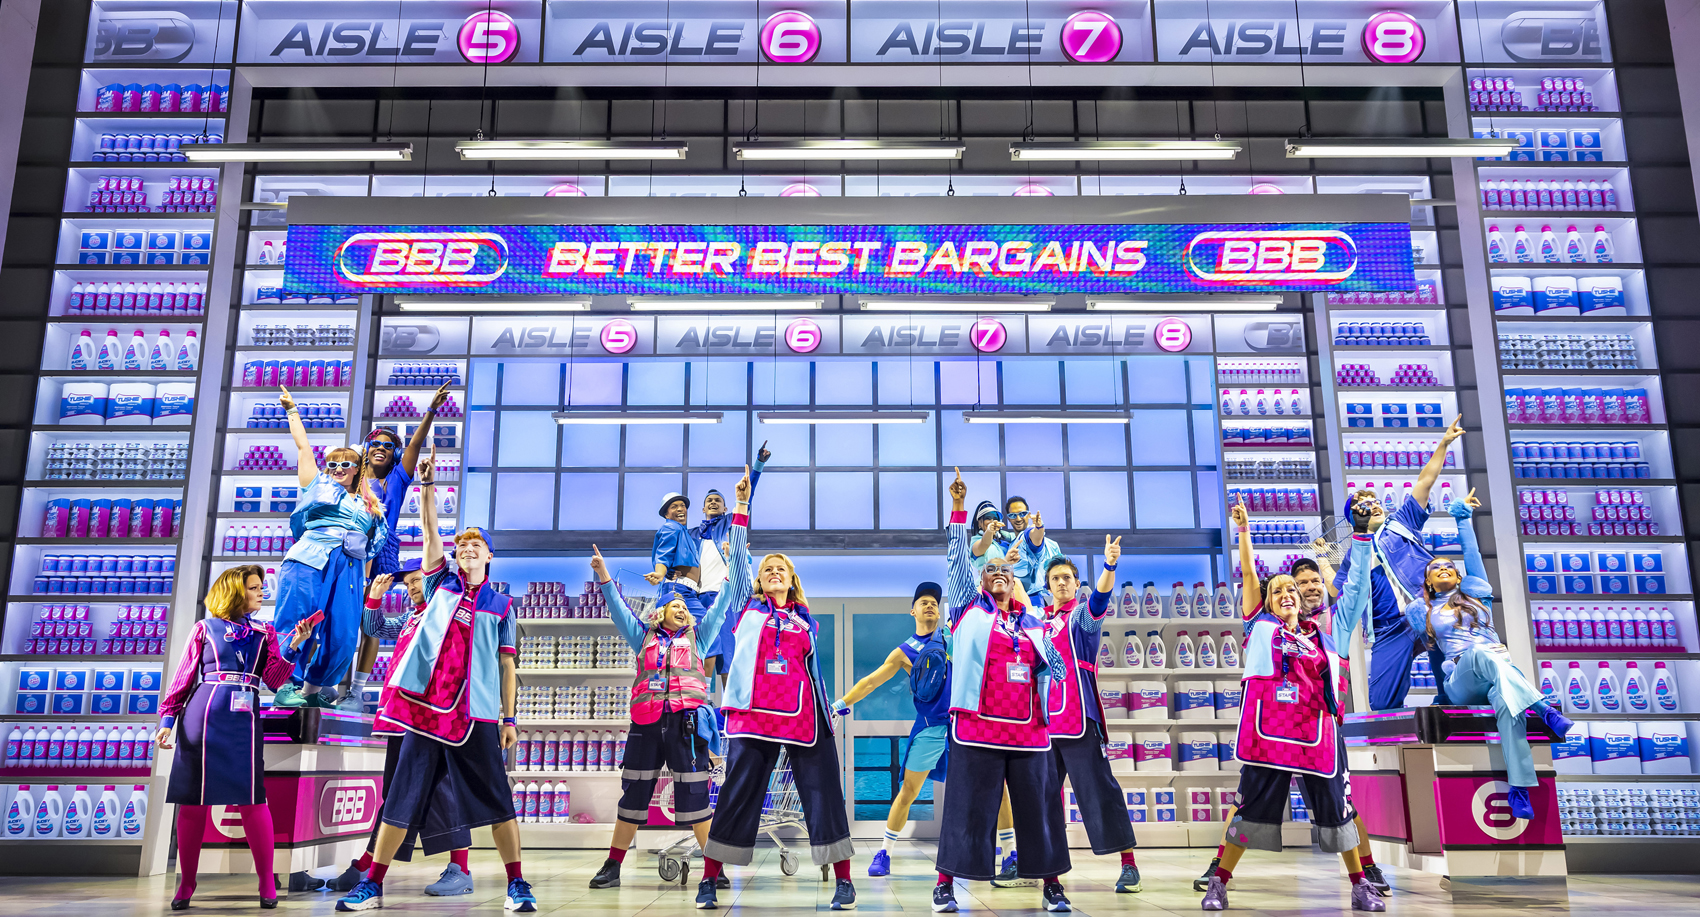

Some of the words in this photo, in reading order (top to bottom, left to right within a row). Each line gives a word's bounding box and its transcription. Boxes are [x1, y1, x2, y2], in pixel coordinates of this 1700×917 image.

[269, 21, 446, 56] AISLE
[466, 21, 511, 57] 5
[572, 21, 746, 56] AISLE
[769, 21, 812, 57] 6
[876, 21, 1047, 56] AISLE
[1072, 21, 1109, 56] 7
[1178, 21, 1348, 56] AISLE
[1373, 21, 1415, 56] 8
[367, 241, 479, 275] BBB
[544, 241, 742, 277] BETTER
[747, 241, 882, 276] BEST
[886, 240, 1149, 276] BARGAINS
[1217, 239, 1327, 272] BBB
[491, 326, 592, 349] AISLE
[605, 325, 633, 349] 5
[675, 326, 777, 349] AISLE
[790, 324, 816, 348] 6
[860, 325, 962, 348] AISLE
[976, 324, 1003, 348] 7
[1046, 325, 1147, 347] AISLE
[1160, 323, 1185, 345] 8
[331, 789, 367, 823] BBB
